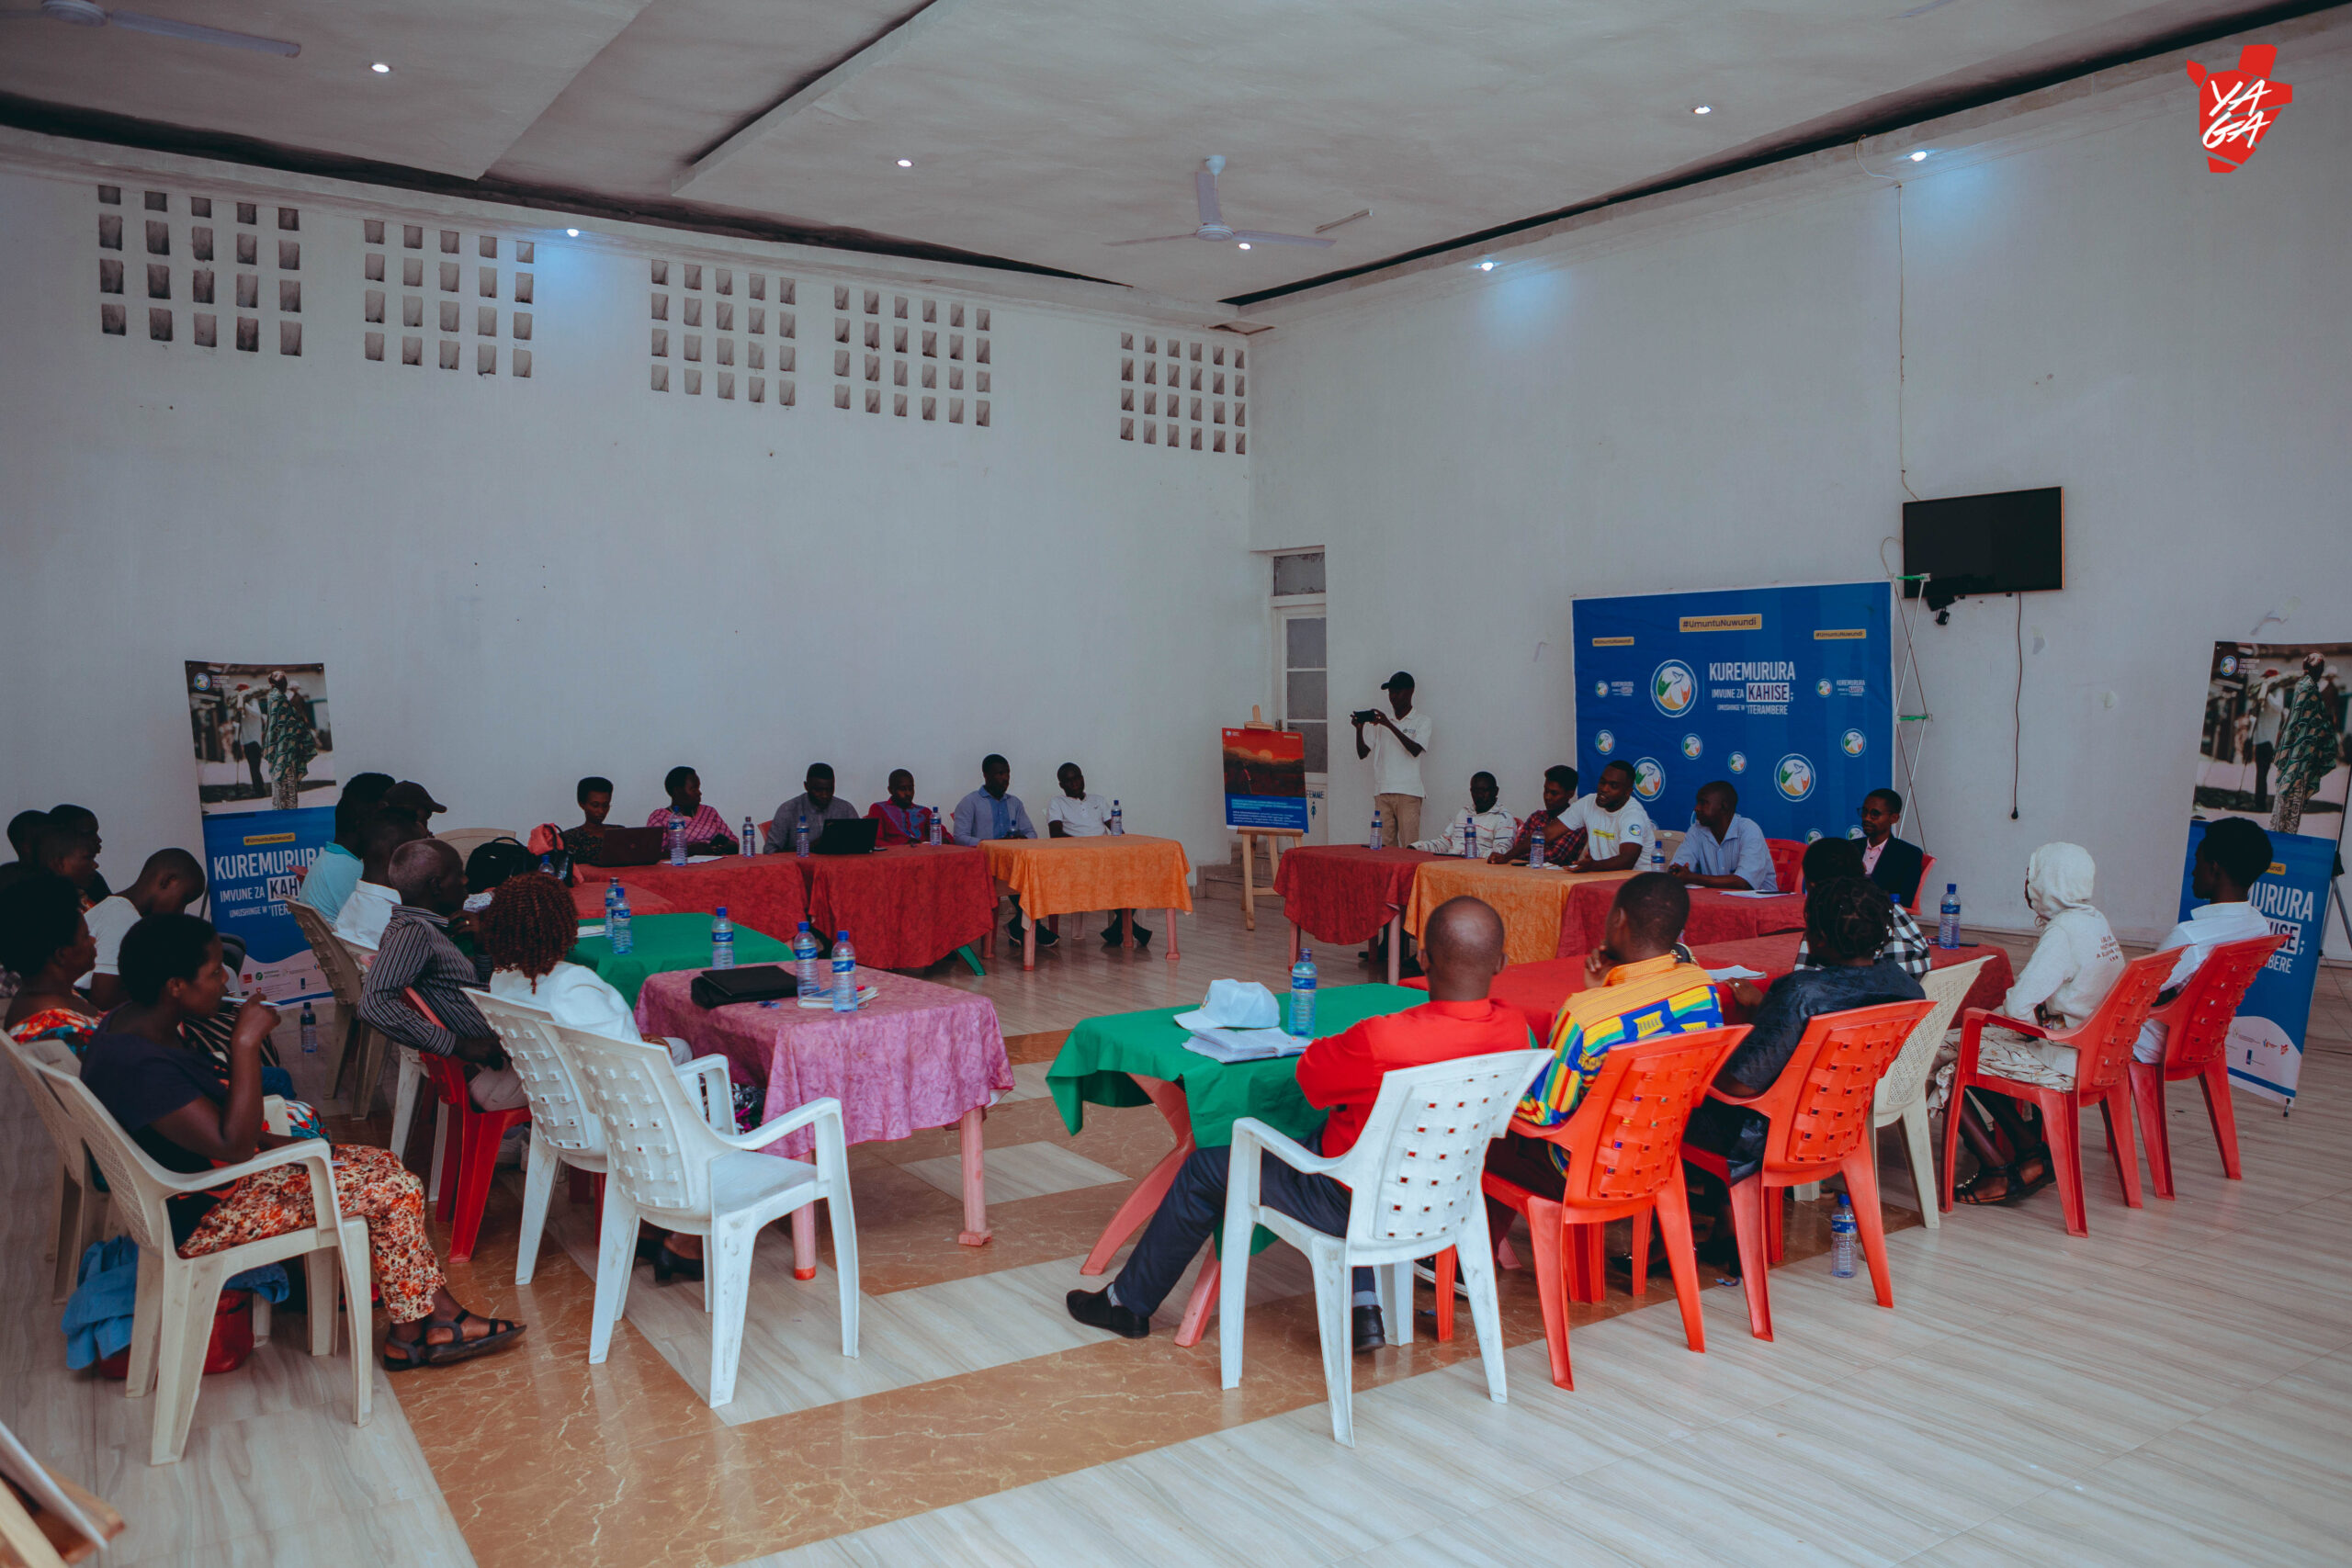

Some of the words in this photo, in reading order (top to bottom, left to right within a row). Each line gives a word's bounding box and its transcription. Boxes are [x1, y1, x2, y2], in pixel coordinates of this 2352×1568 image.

[1682, 617, 1757, 629] #UmuntuNuwundi
[1709, 661, 1795, 682] KUREMURURA
[1712, 689, 1736, 699] IMVUNE
[1736, 689, 1745, 699] ZA
[1306, 790, 1325, 799] FEMME
[214, 846, 325, 881] KUREMURUR
[220, 887, 254, 903] IMVUNE
[254, 886, 266, 898] ZA
